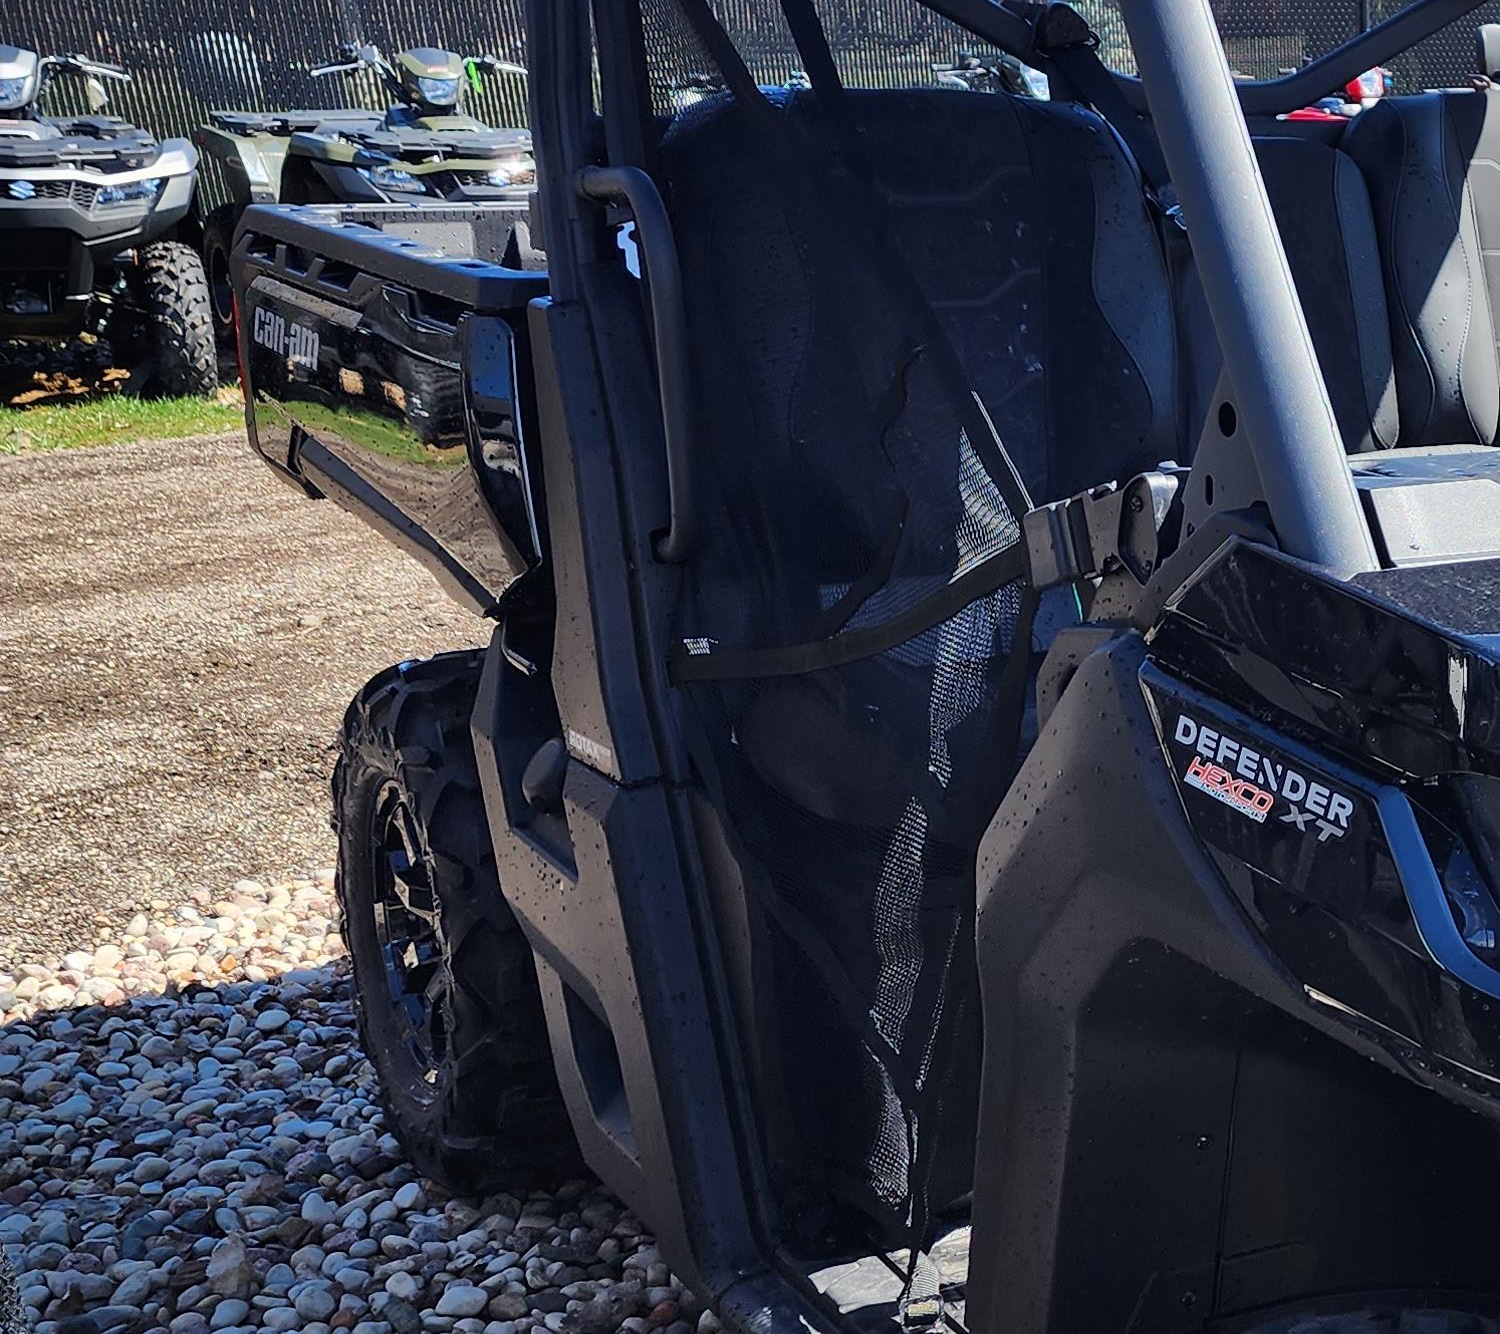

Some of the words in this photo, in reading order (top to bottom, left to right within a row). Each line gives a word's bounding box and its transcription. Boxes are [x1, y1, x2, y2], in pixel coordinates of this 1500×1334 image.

[254, 306, 320, 371] can-am
[1174, 714, 1353, 827] DEFENDER
[1187, 755, 1274, 813] HEXCO
[1279, 803, 1344, 843] XT
